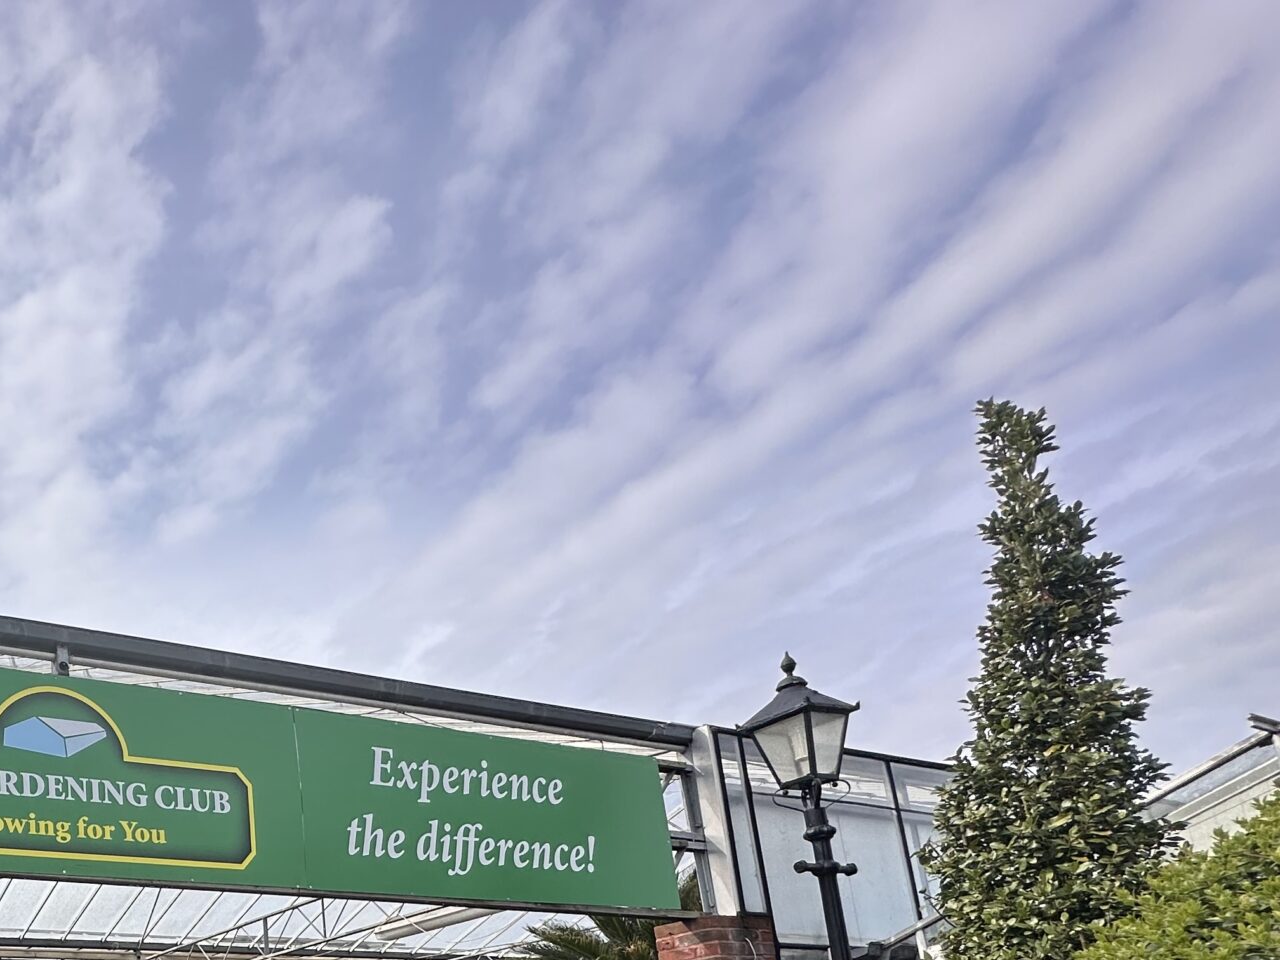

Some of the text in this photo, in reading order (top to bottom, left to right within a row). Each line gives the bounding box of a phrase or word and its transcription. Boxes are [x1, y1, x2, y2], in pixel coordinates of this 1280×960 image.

[369, 746, 564, 805] Experience
[154, 785, 232, 814] CLUB
[76, 816, 116, 841] for
[119, 820, 168, 844] You
[347, 813, 596, 876] the difference!
